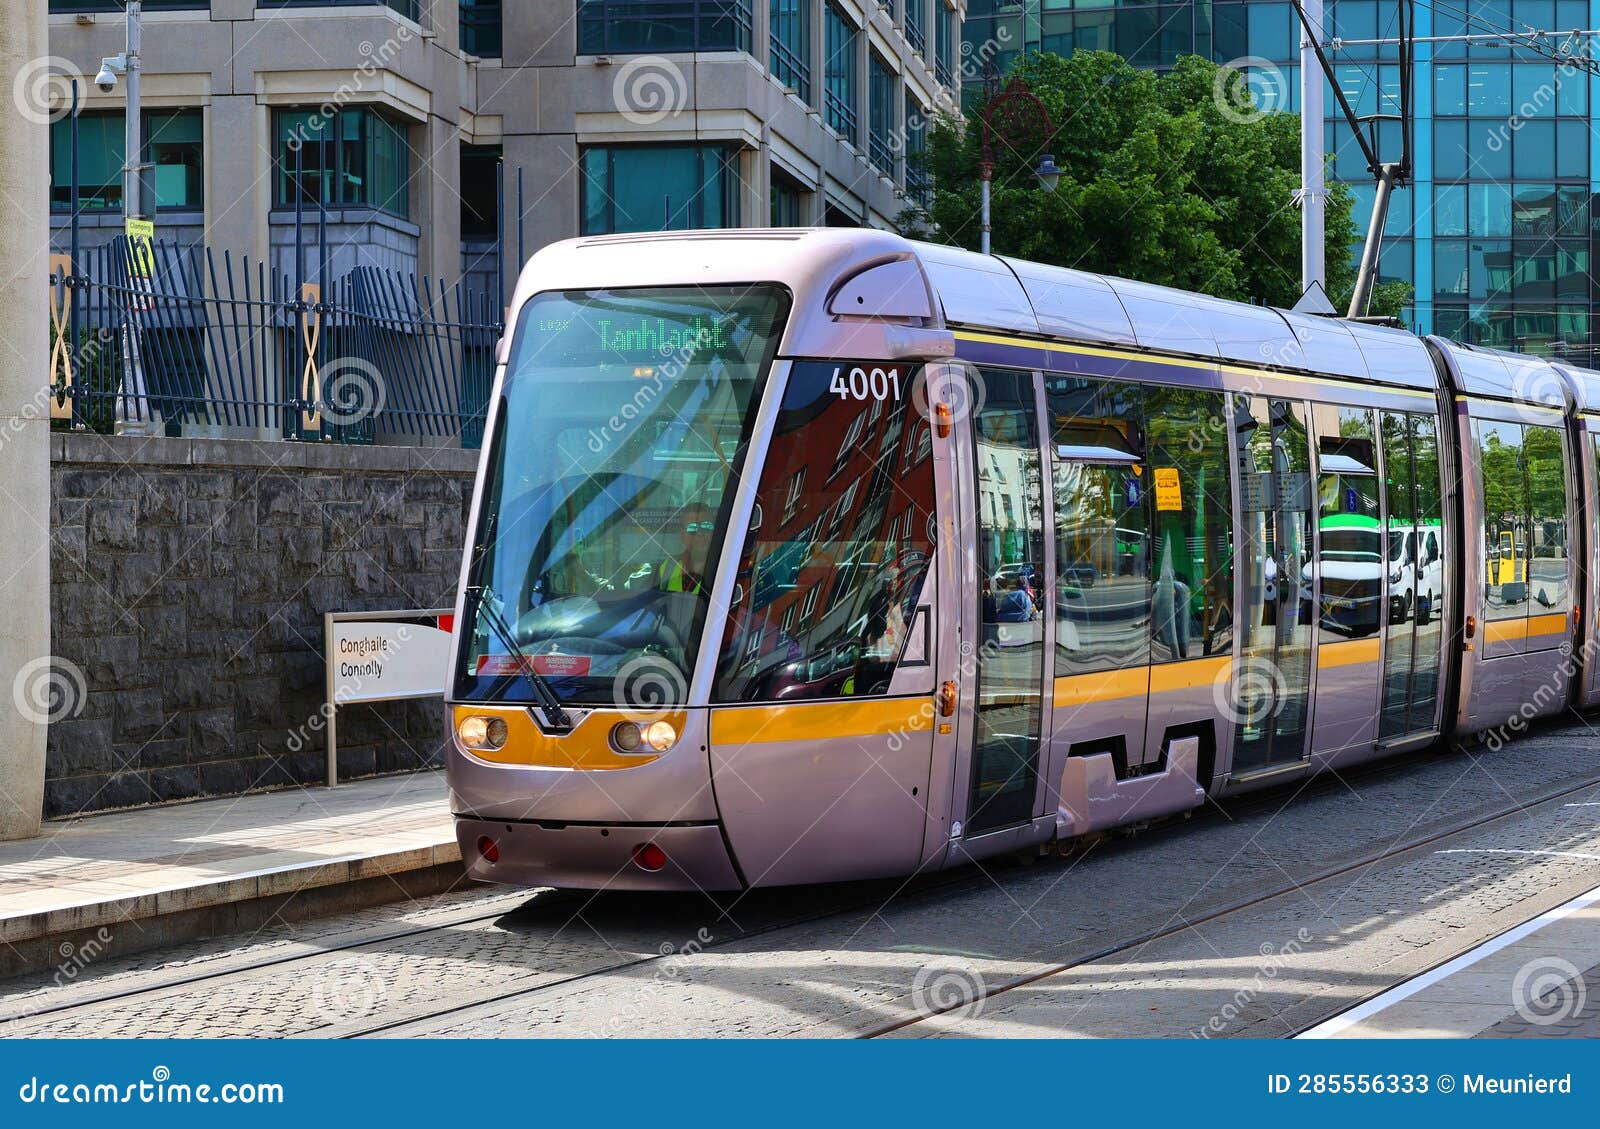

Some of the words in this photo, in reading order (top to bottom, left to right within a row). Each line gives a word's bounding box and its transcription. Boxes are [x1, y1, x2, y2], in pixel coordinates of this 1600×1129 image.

[829, 367, 900, 402] 4001
[340, 636, 388, 656] Conghaile
[340, 660, 383, 678] Connolly
